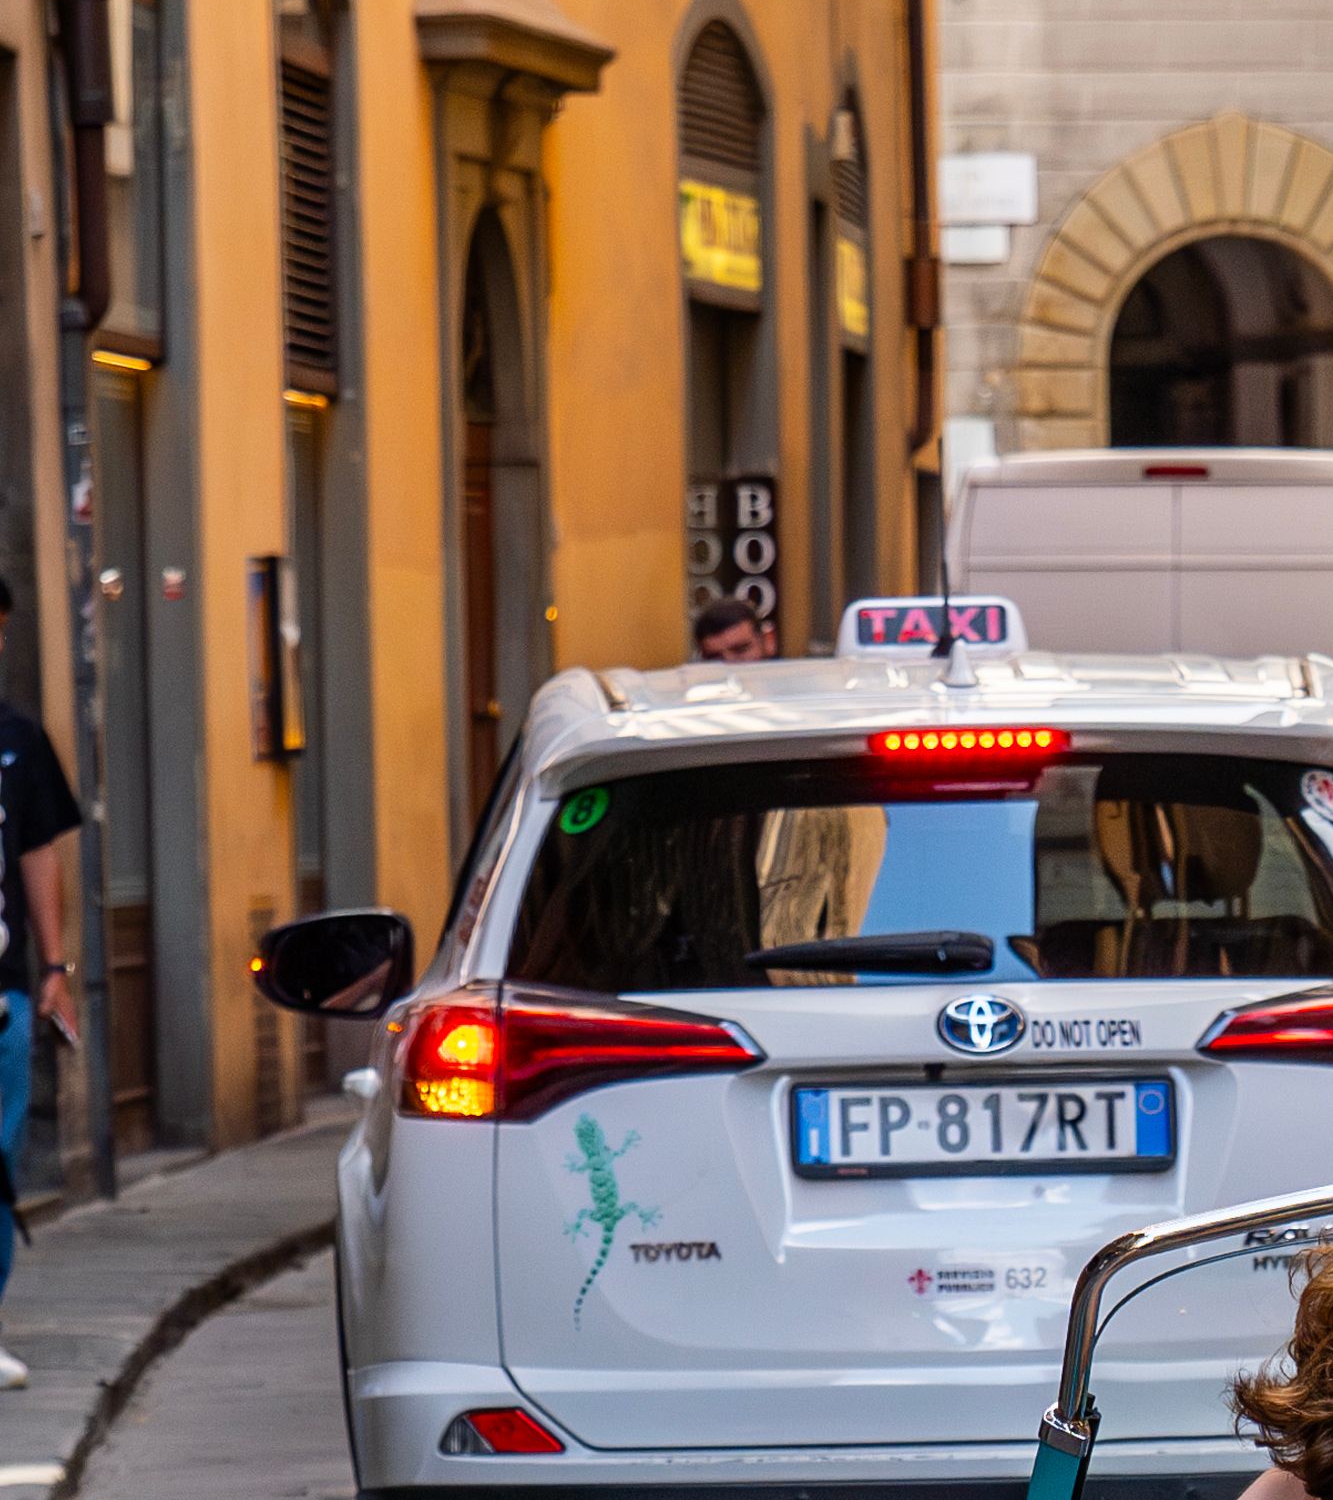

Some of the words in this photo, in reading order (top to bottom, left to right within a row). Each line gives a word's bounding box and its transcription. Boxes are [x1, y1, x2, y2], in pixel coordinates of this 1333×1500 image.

[860, 606, 1001, 643] TAXI
[570, 793, 596, 828] 8
[1031, 1019, 1056, 1048] DO
[1059, 1019, 1091, 1048] NOT
[1096, 1018, 1142, 1047] OPEN
[628, 1241, 723, 1262] TOYOTA
[1006, 1266, 1046, 1290] 632
